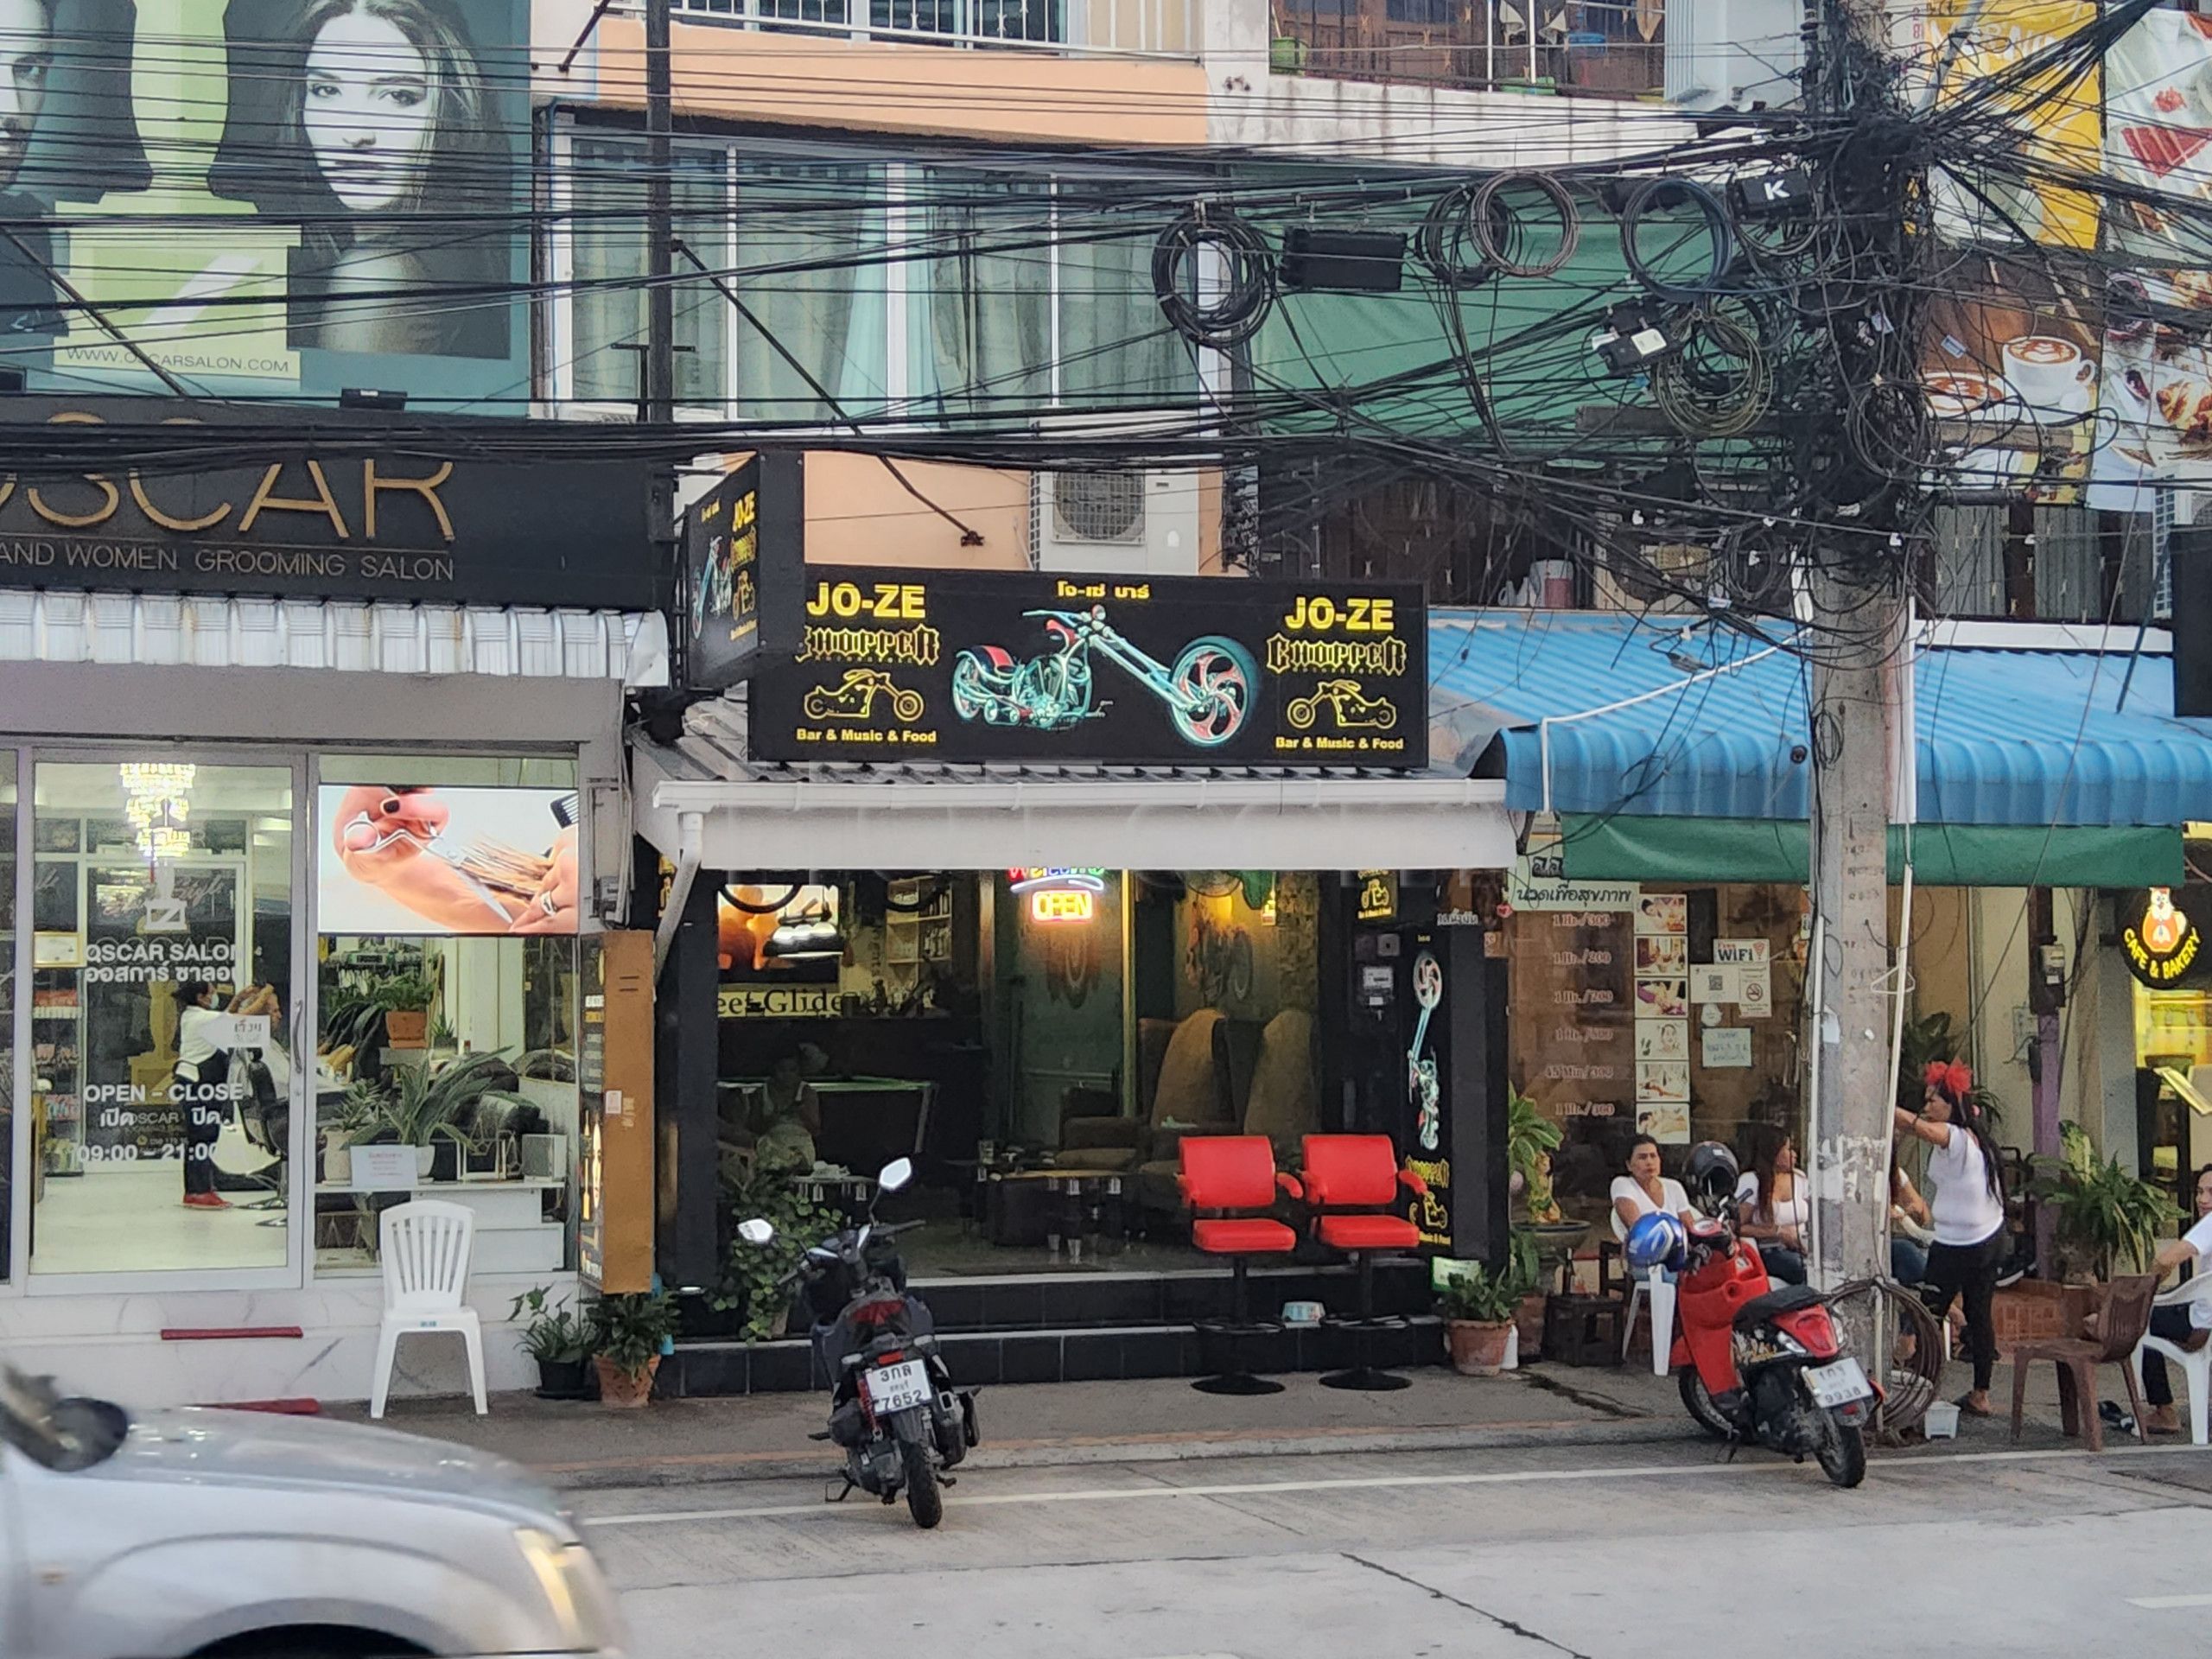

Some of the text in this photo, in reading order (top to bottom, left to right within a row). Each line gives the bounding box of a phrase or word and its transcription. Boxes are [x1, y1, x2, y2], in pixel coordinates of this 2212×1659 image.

[1764, 180, 1790, 200] K
[0, 410, 454, 542] SCAR
[0, 543, 454, 582] AND WOMEN GROOMING SALON
[806, 582, 926, 619] JO-ZE
[1284, 596, 1395, 631] JO-ZE
[796, 728, 938, 743] Bar & Music & Food
[1275, 736, 1404, 750] Bar & Music & Food
[1037, 893, 1089, 918] OPEN
[86, 943, 164, 963] OSCAR
[2124, 925, 2202, 980] CAFE & BAKERY
[86, 961, 170, 982] ออสการ์
[764, 988, 843, 1014] Glide
[85, 1084, 145, 1103] OPEN
[168, 1084, 244, 1102] CLOSE
[100, 1107, 136, 1127] เปิด
[79, 1144, 138, 1161] 09:00
[880, 1389, 924, 1411] 7652
